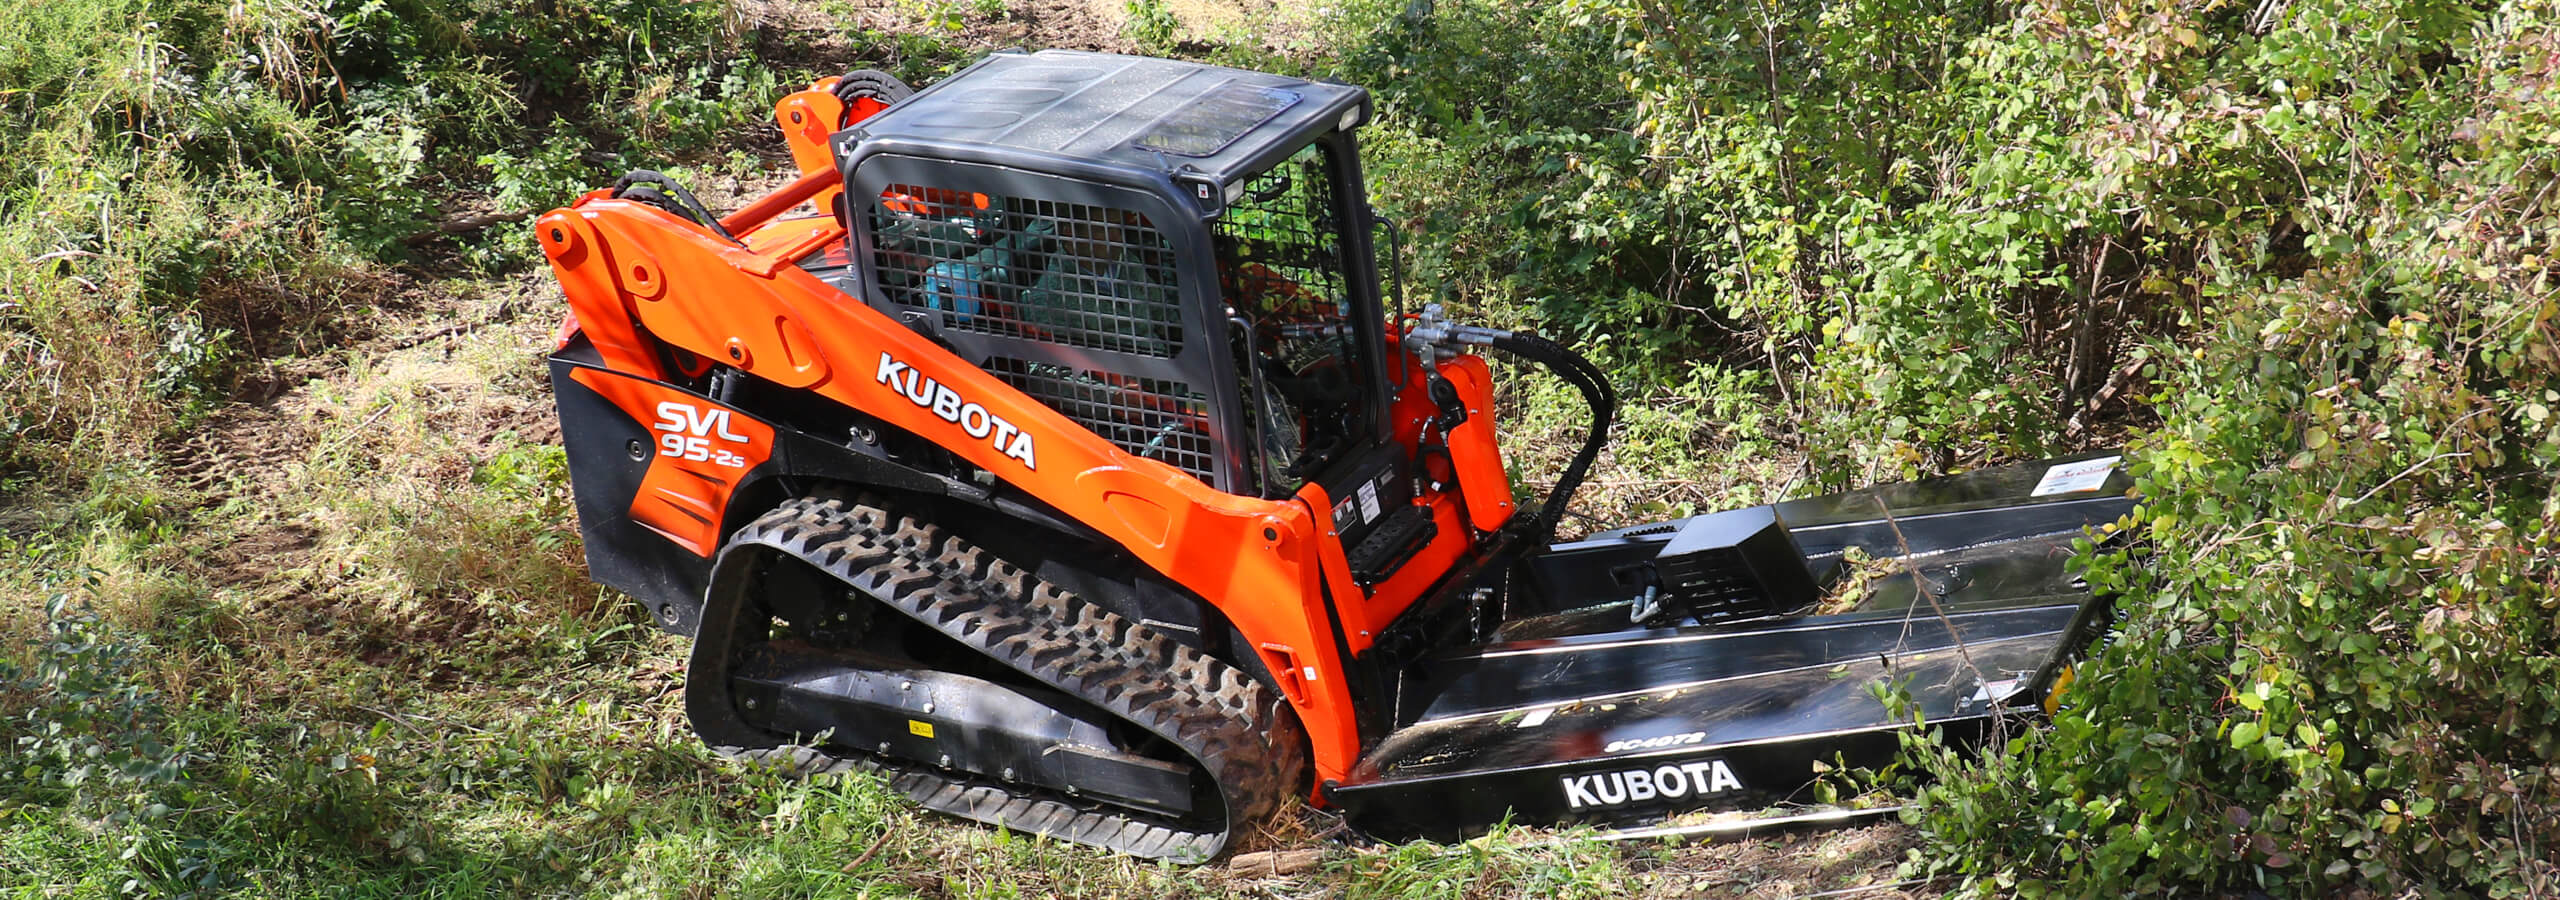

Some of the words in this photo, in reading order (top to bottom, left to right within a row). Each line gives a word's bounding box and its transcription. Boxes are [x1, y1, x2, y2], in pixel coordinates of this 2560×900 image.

[654, 401, 749, 443] SVL
[876, 352, 1036, 470] KUBOTA
[1562, 760, 1743, 809] KUBOTA
